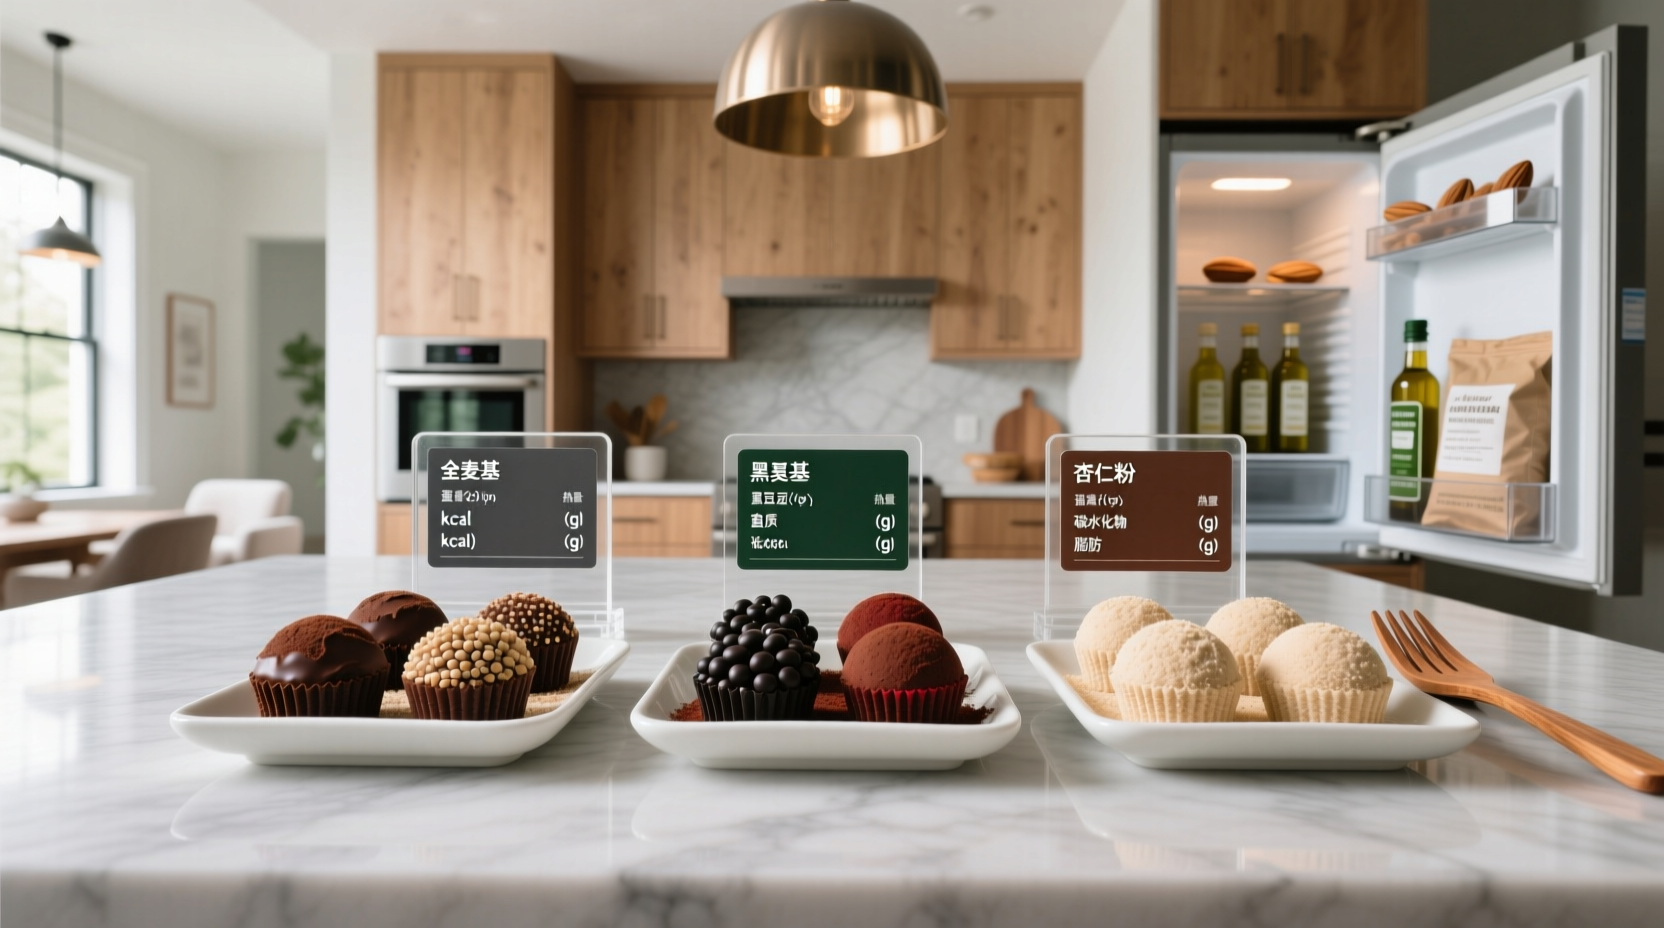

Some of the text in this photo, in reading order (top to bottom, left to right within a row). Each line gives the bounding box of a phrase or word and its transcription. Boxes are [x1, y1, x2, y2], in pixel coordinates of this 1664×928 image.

[441, 459, 500, 480] 全麦基
[1073, 462, 1136, 484] 杏仁粉
[441, 510, 471, 526] kcal
[875, 514, 895, 531] (g)
[1198, 515, 1219, 533] (g)
[441, 532, 476, 550] kcal)
[564, 533, 584, 552] (g)
[875, 535, 895, 554] (g)
[1198, 537, 1219, 556] (g)
